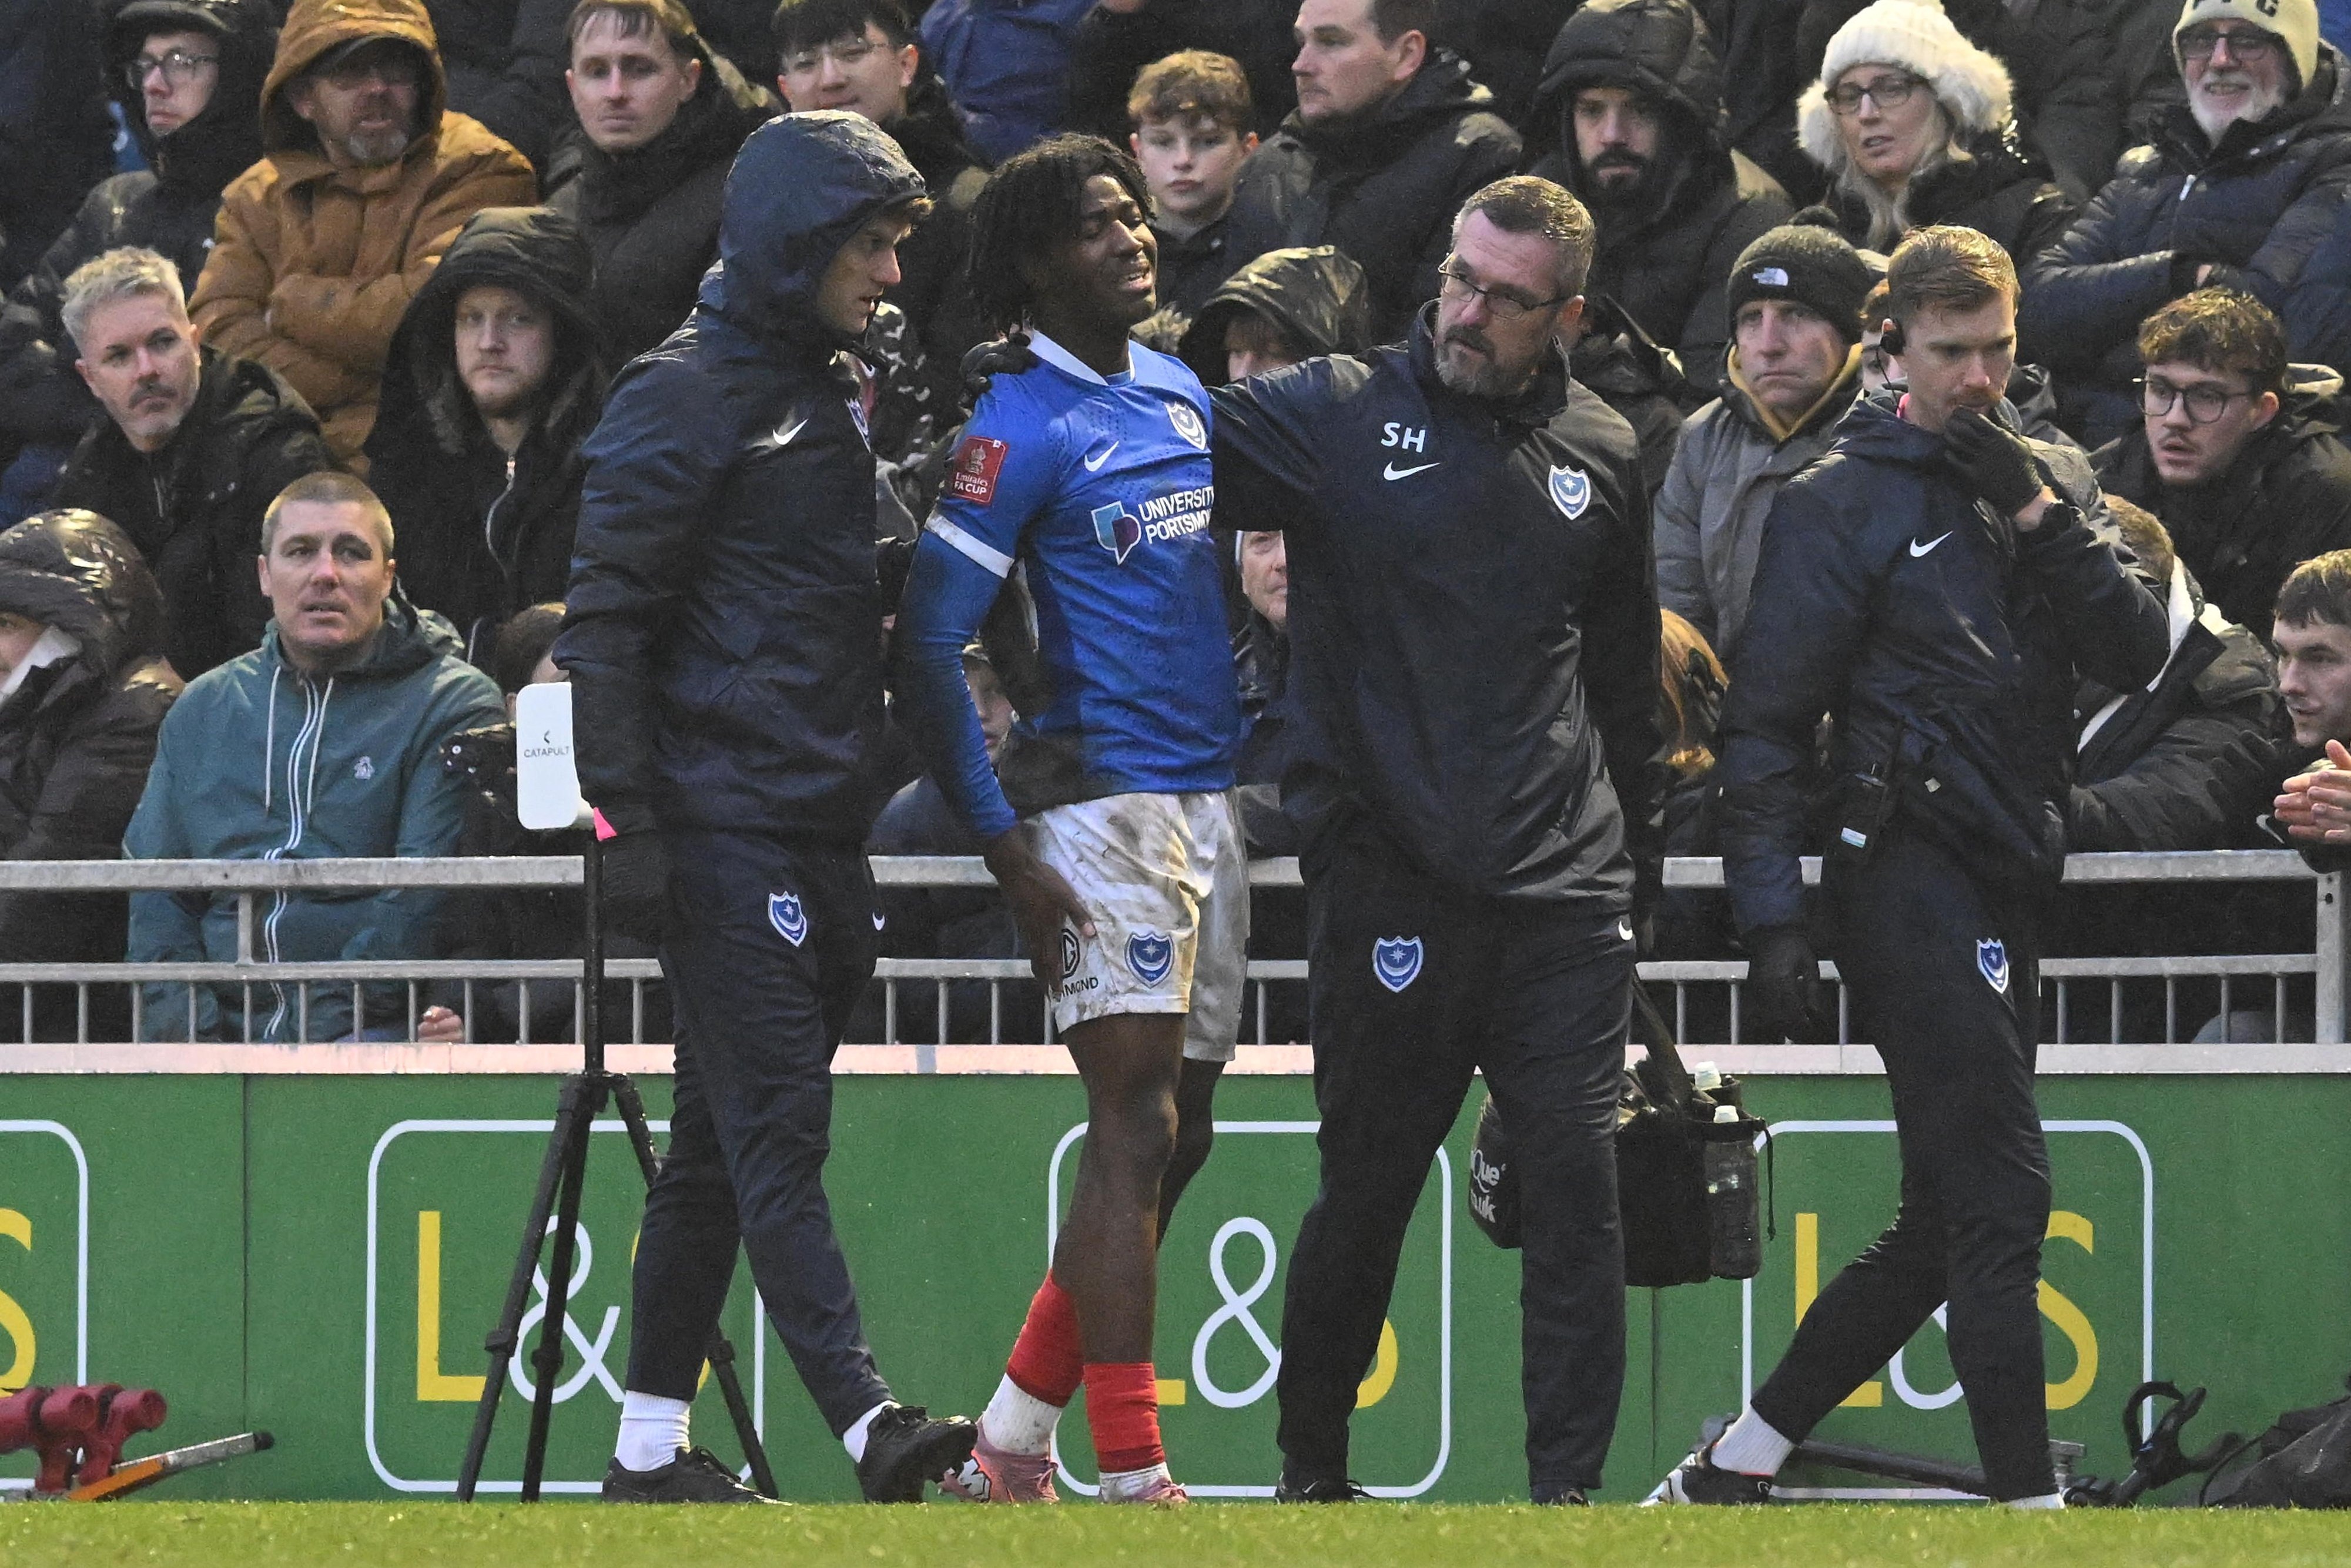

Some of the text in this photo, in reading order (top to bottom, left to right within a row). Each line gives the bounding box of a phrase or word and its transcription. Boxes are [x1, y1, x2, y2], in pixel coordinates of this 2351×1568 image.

[1381, 422, 1425, 453] SH
[954, 481, 987, 495] FA CUP
[524, 746, 570, 758] CATAPULT
[1063, 977, 1099, 997] MOND
[417, 1210, 710, 1403] L&
